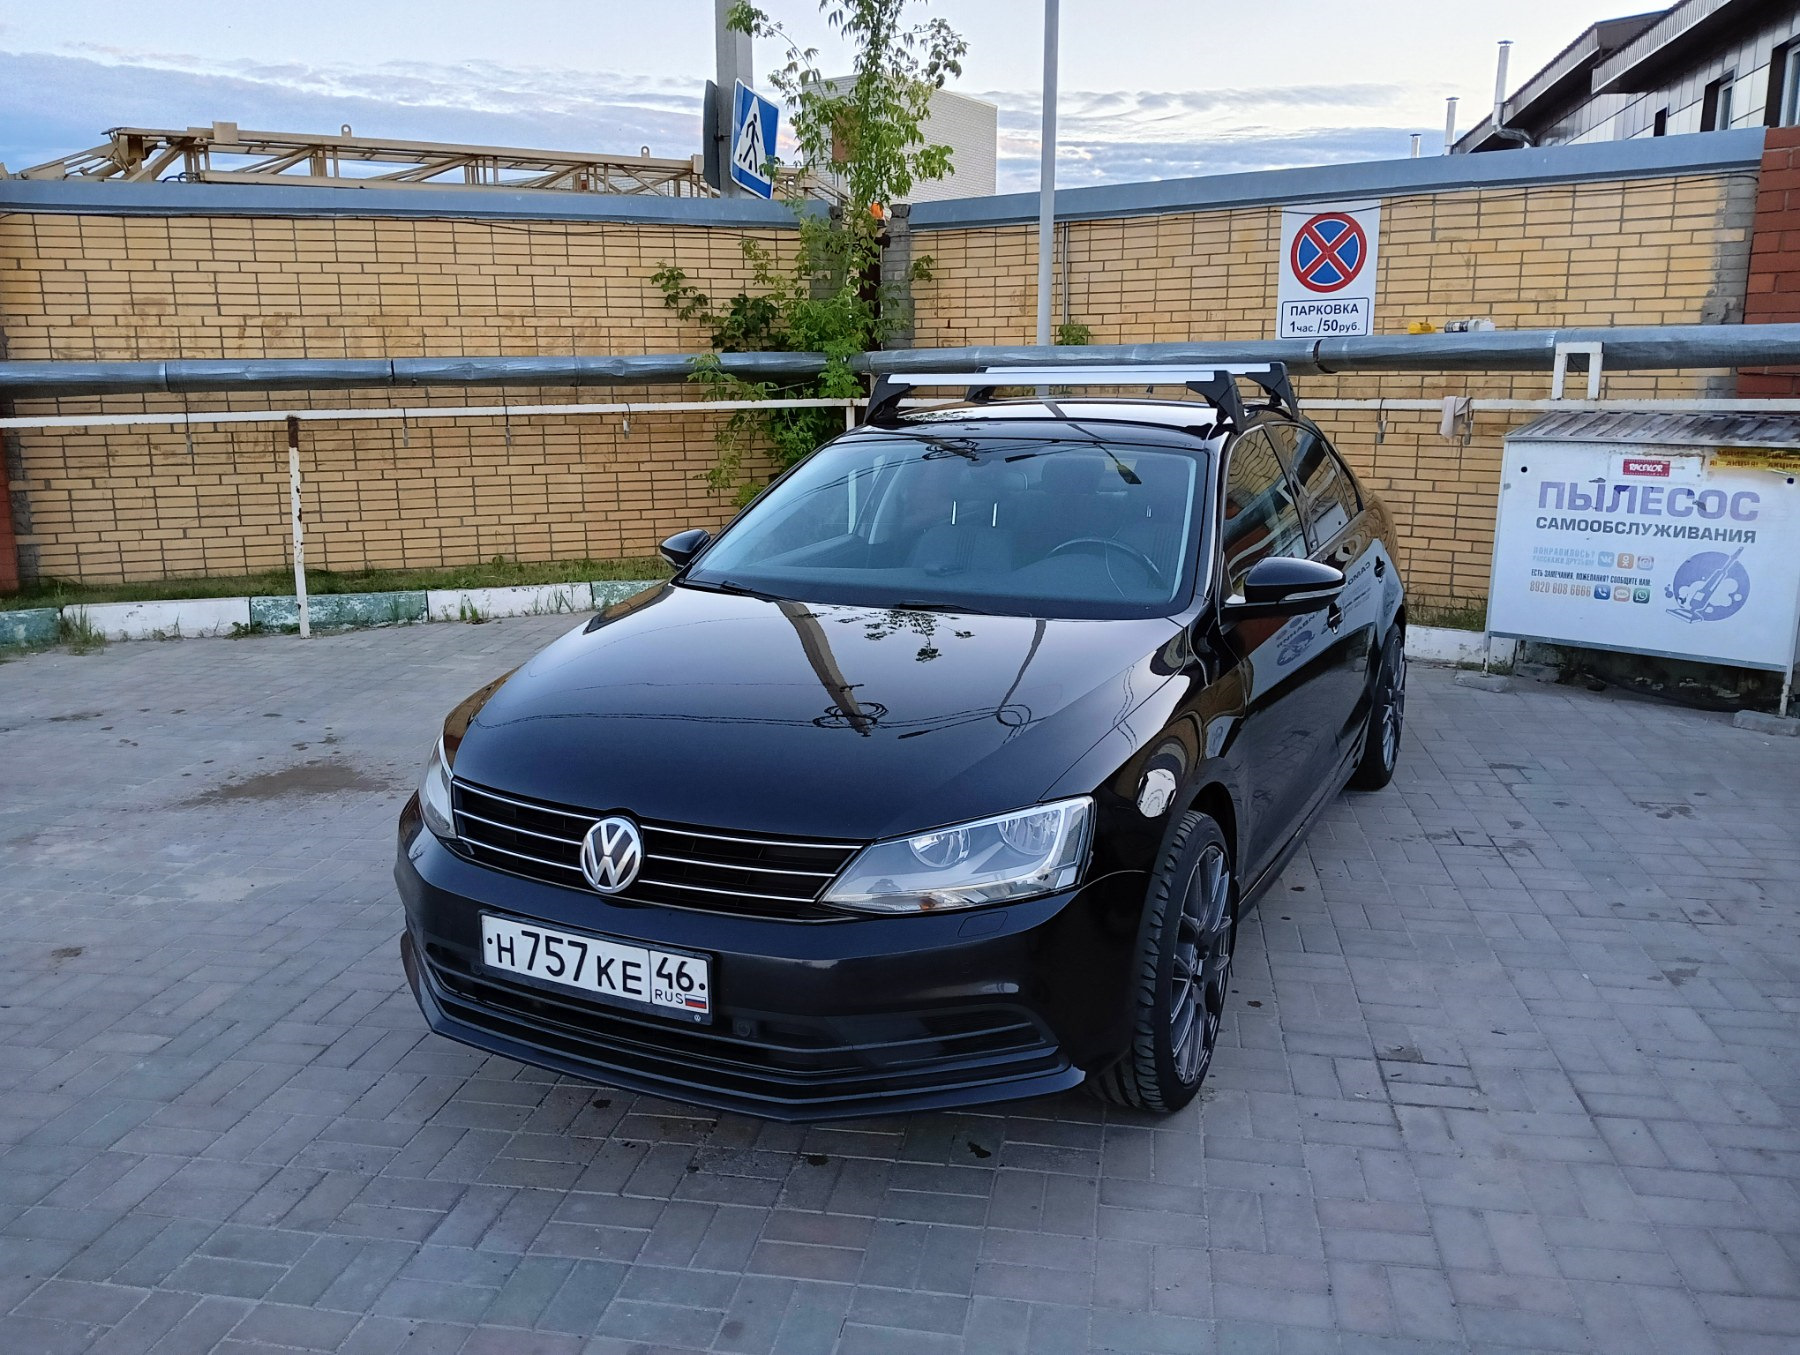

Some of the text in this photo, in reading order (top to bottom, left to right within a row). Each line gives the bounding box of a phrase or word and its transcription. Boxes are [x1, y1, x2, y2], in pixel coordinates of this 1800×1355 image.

[1290, 303, 1359, 316] ПАРКОВКА
[1538, 481, 1761, 522] ПЫЛЕСОС
[1535, 516, 1757, 544] САМООБСЛУЖИВАНИЯ
[1531, 568, 1543, 577] ЕСТЬ
[1610, 575, 1638, 585] СООБЩИТЕ
[1530, 580, 1550, 593] 8920
[656, 956, 695, 992] 46
[654, 988, 684, 1005] RUS
